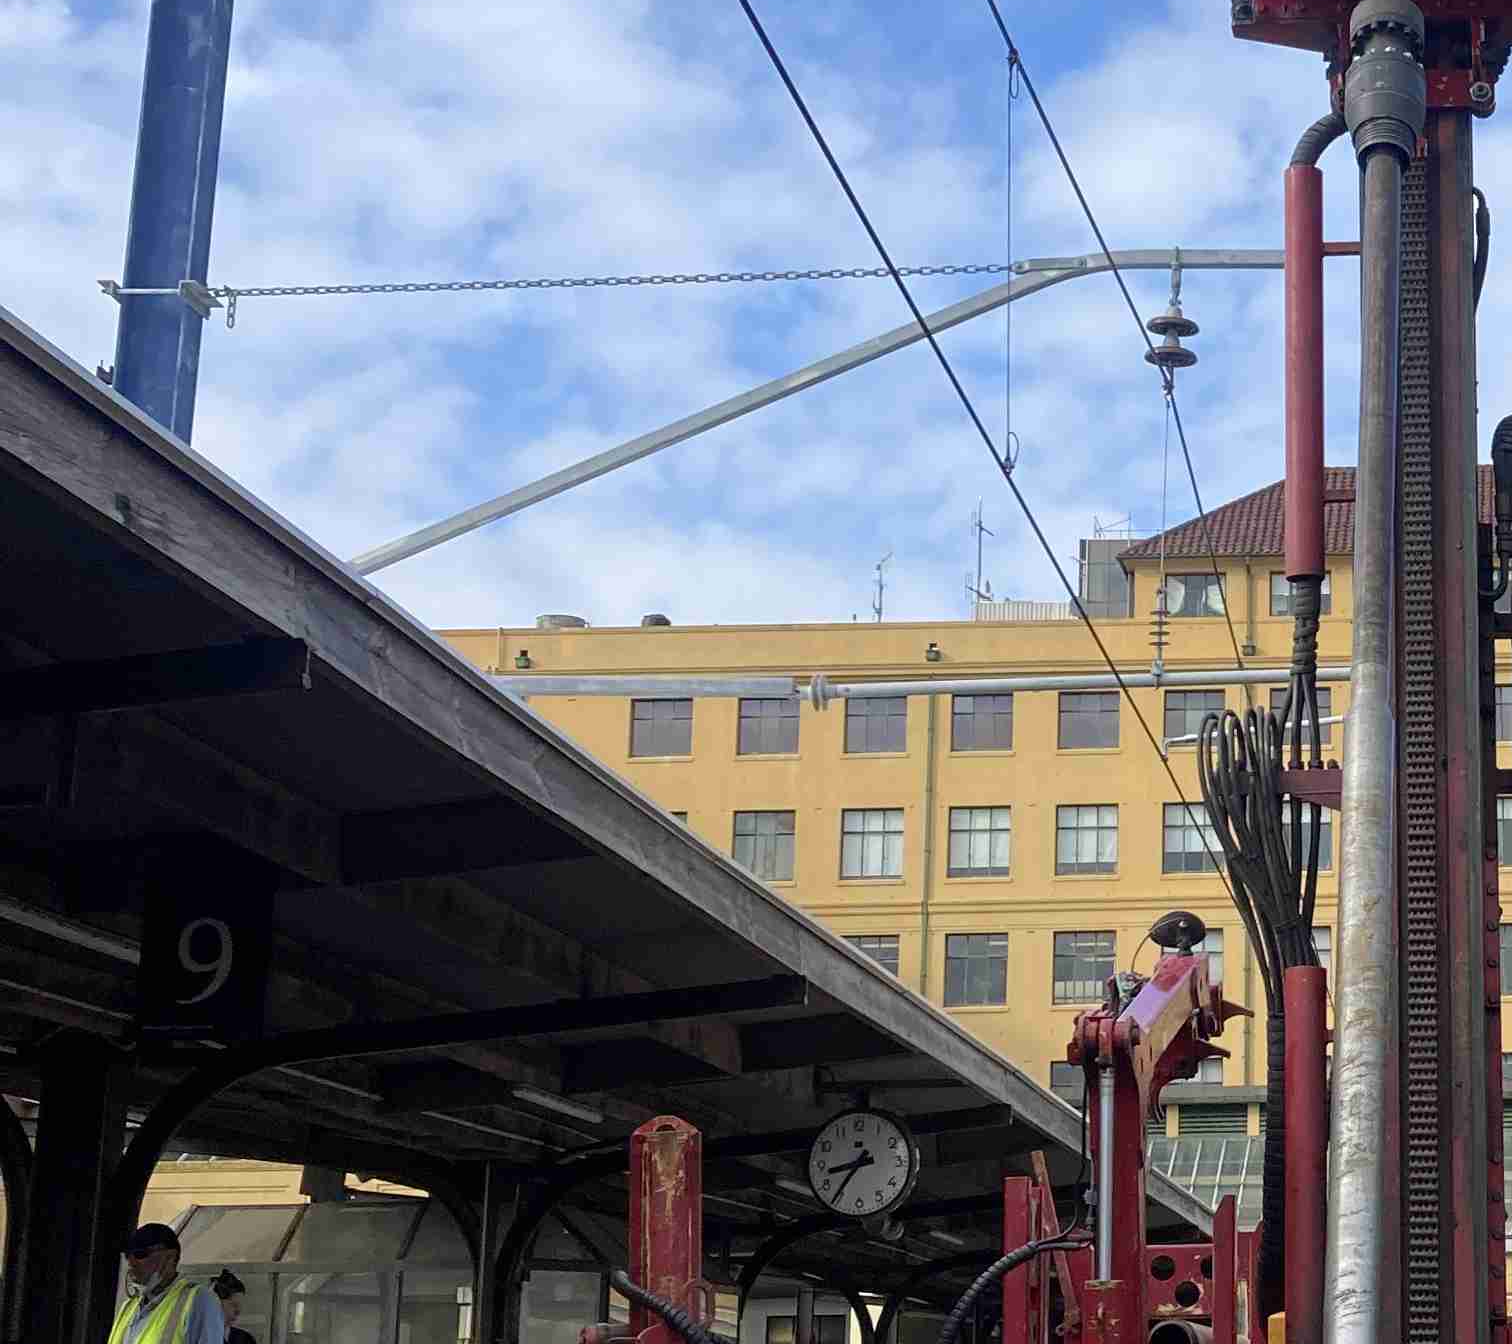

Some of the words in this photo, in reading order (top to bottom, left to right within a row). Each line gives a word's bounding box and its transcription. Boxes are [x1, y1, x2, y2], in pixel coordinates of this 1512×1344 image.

[176, 917, 233, 1005] 9
[853, 1120, 865, 1132] 12
[887, 1137, 898, 1149] 2
[817, 1160, 826, 1170] 9
[896, 1156, 903, 1167] 3
[822, 1178, 831, 1191] 8
[888, 1175, 897, 1188] 4
[875, 1191, 884, 1202] 5
[855, 1198, 864, 1208] 6
